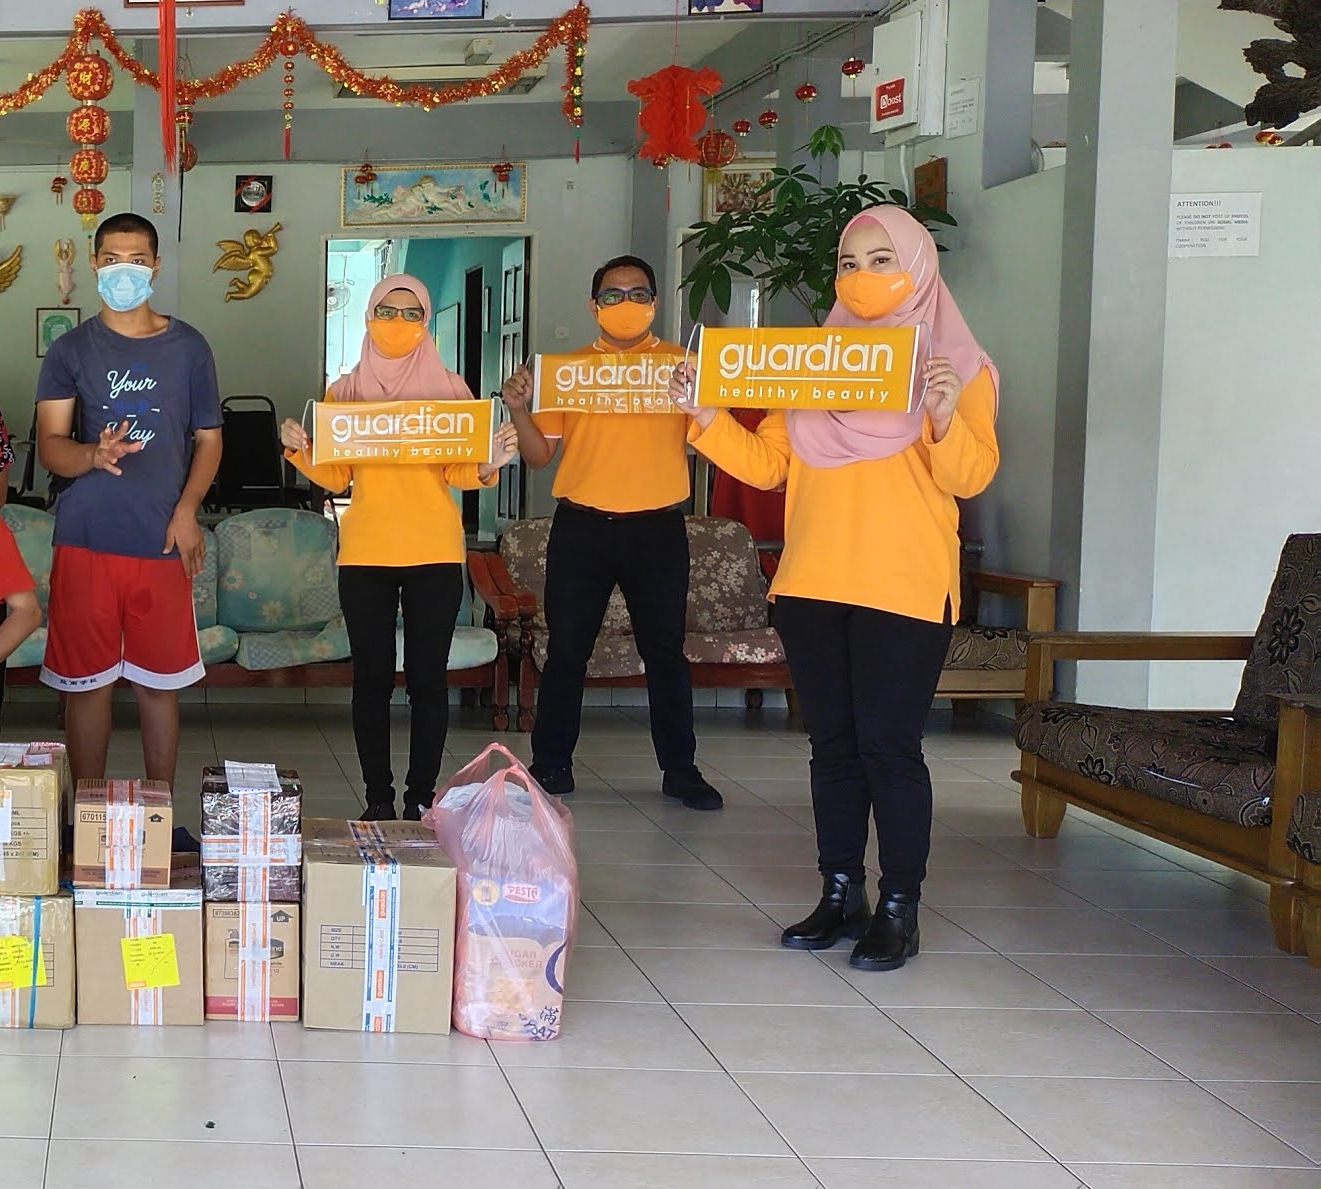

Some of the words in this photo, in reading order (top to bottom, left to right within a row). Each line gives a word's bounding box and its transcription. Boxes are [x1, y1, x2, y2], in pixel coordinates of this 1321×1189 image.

[880, 93, 902, 109] Boost
[719, 334, 893, 379] guardian
[555, 359, 675, 391] guardia
[107, 370, 157, 399] Your
[557, 396, 622, 406] healthy
[719, 385, 799, 400] healthy
[813, 386, 889, 403] beauty
[331, 406, 474, 443] guardian
[333, 448, 400, 458] healthy
[411, 446, 473, 457] beauty
[82, 812, 106, 820] 670115
